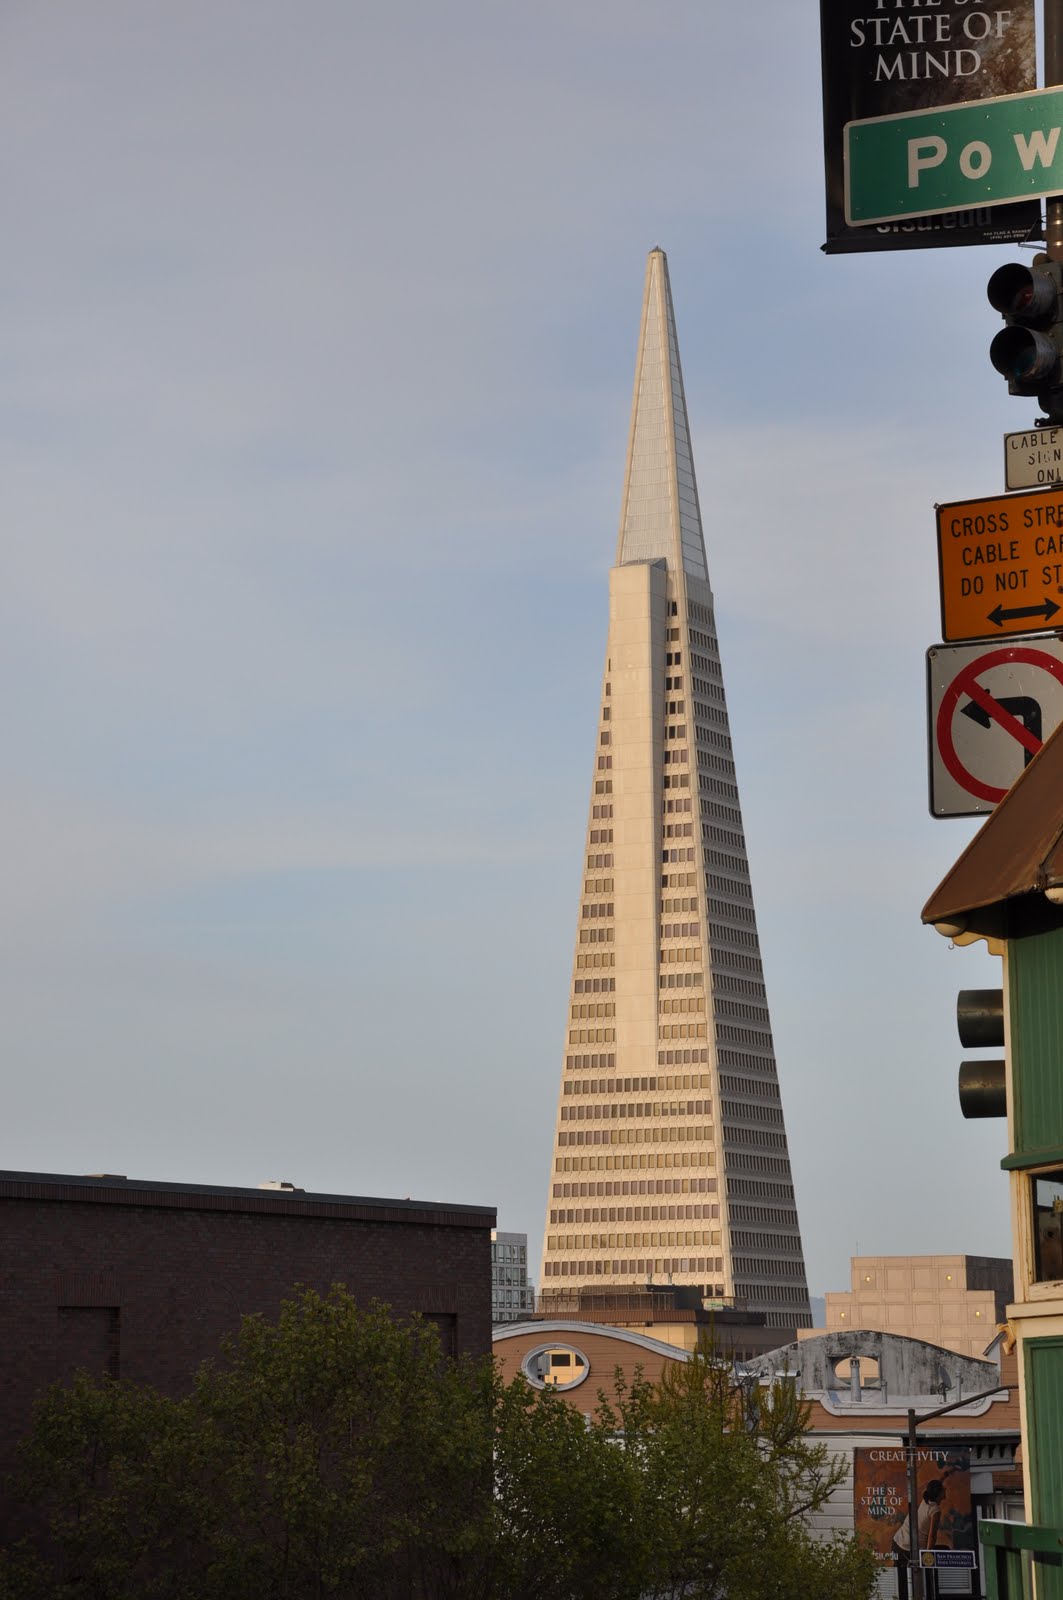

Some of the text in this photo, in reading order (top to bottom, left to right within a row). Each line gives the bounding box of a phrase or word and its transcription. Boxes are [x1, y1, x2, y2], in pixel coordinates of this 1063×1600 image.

[850, 10, 1012, 47] STATE OF
[1011, 431, 1057, 450] CABLE
[951, 512, 1009, 538] CROSS
[962, 541, 1020, 566] CABLE
[961, 575, 984, 596] DO
[995, 569, 1029, 592] NOT
[861, 1496, 903, 1506] STATE OF
[866, 1486, 897, 1496] THE SF
